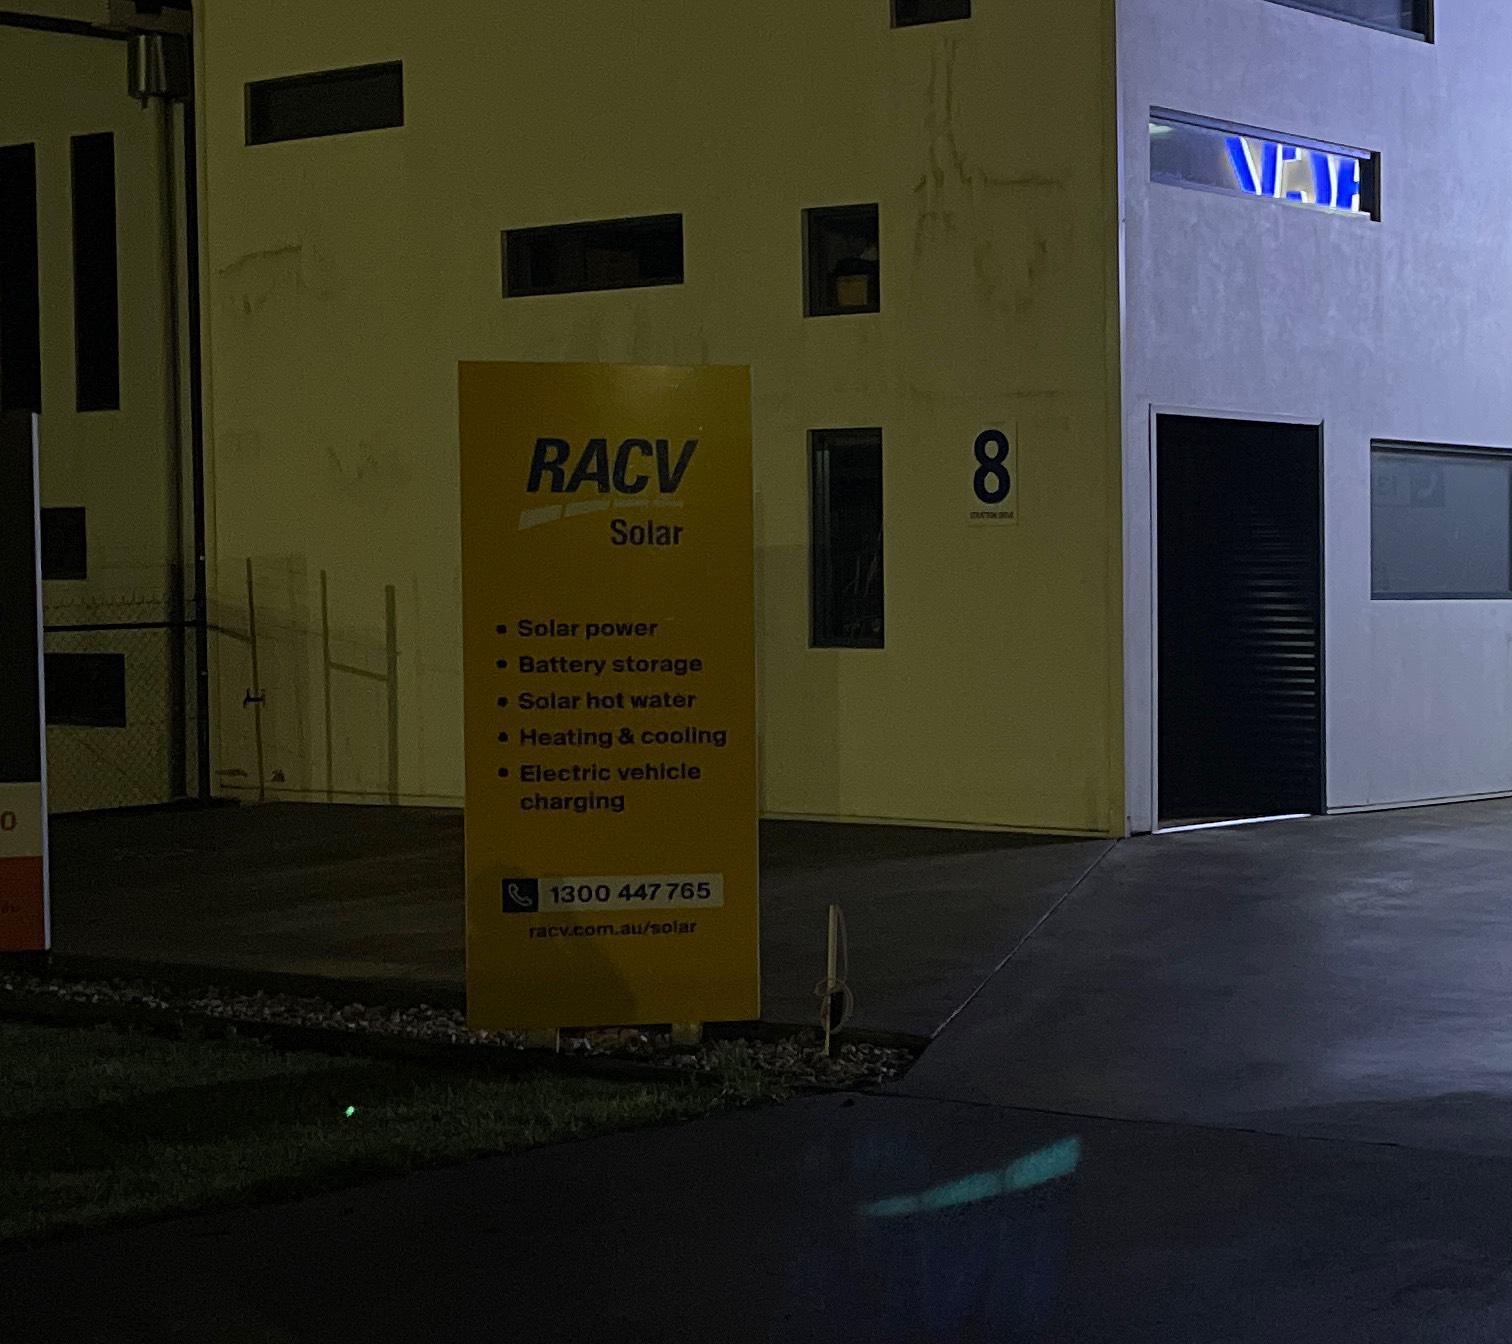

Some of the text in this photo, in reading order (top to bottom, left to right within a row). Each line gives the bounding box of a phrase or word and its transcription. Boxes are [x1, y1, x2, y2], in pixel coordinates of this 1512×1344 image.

[526, 437, 699, 494] RACV
[974, 429, 1010, 504] 8
[610, 518, 684, 546] Solar
[518, 619, 658, 640] Solar power
[519, 655, 703, 676] Battery storage
[518, 692, 697, 710] Solar hot water
[519, 726, 728, 748] Heating & cooling
[520, 762, 702, 782] Electric vehicle
[520, 792, 625, 812] charging
[550, 882, 712, 904] 1300 447 765
[528, 920, 698, 939] racv.com.au/solar
